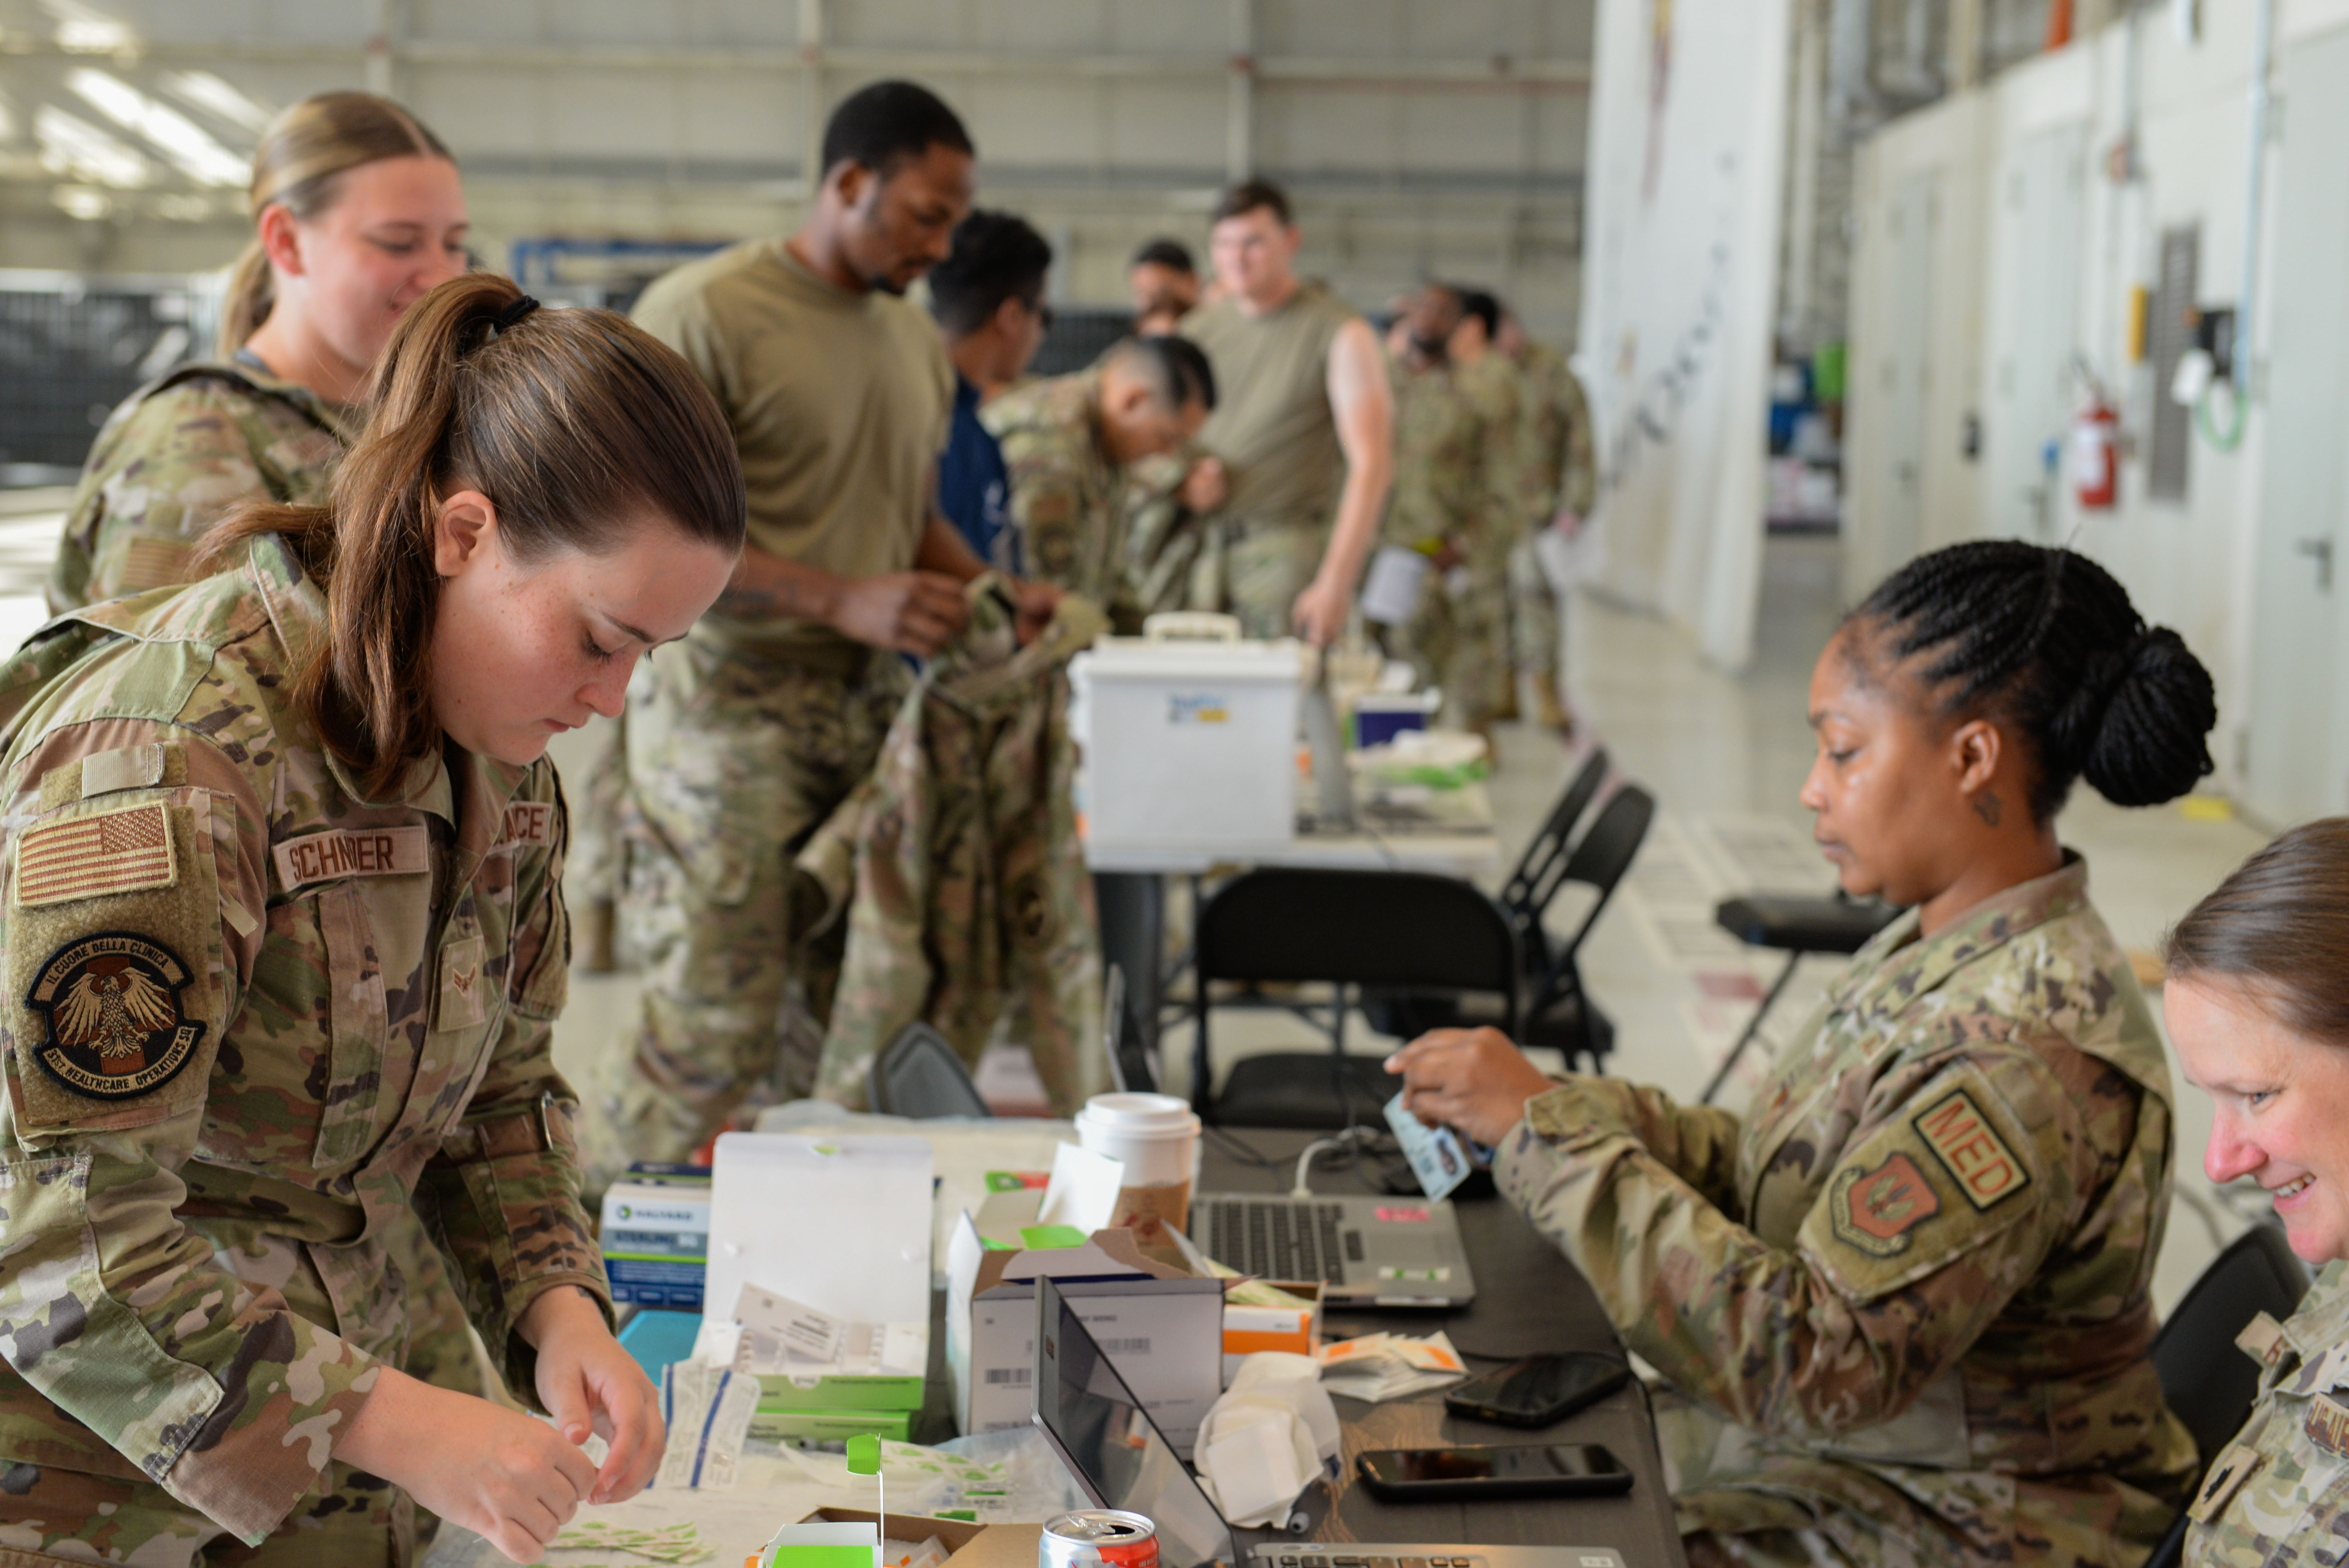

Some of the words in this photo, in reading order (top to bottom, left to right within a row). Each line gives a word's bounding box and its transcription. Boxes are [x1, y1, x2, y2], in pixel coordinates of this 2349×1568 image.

[46, 974, 59, 985] IL
[54, 946, 90, 975] CUORE
[92, 941, 126, 952] DELLA
[130, 942, 169, 968] CLINICA
[47, 1049, 65, 1070] 31ST
[65, 1066, 130, 1090] HEALTHCARE
[136, 1043, 186, 1086] OPERATIONS
[179, 1028, 191, 1042] SQ
[1924, 1100, 2013, 1195] MED
